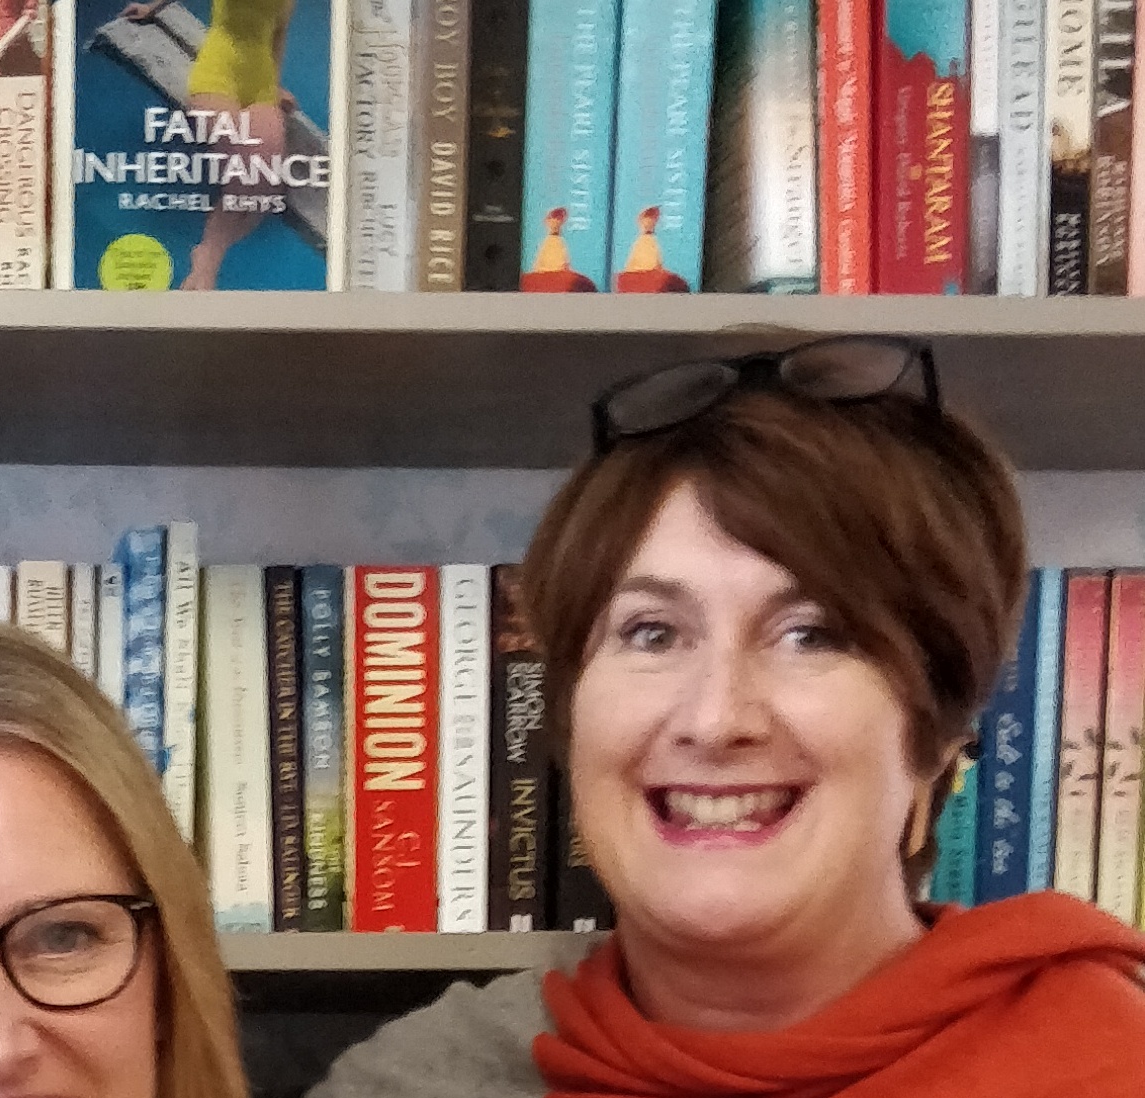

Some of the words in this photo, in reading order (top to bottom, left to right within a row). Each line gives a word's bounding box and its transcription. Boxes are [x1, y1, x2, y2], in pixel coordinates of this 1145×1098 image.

[144, 106, 264, 145] FATAL
[356, 52, 377, 159] FACTORY
[431, 63, 459, 122] BOY
[15, 92, 36, 237] DANGEROUS
[74, 148, 332, 187] INHERITANCE
[429, 141, 458, 216] DAVID
[924, 81, 955, 265] SHANTARAM
[118, 192, 215, 212] RACHEL
[222, 194, 287, 213] RHYS
[380, 204, 398, 257] LUCY
[428, 230, 456, 284] RICE
[175, 561, 193, 590] All
[309, 588, 333, 659] POLLY
[451, 578, 479, 703] GEORGE
[362, 572, 427, 792] DOMINION
[505, 662, 529, 764] SCARROW
[523, 662, 546, 731] SIMON
[371, 799, 396, 913] SANSOM
[450, 754, 477, 923] SAUNDERS
[508, 778, 538, 901] INVICTUS
